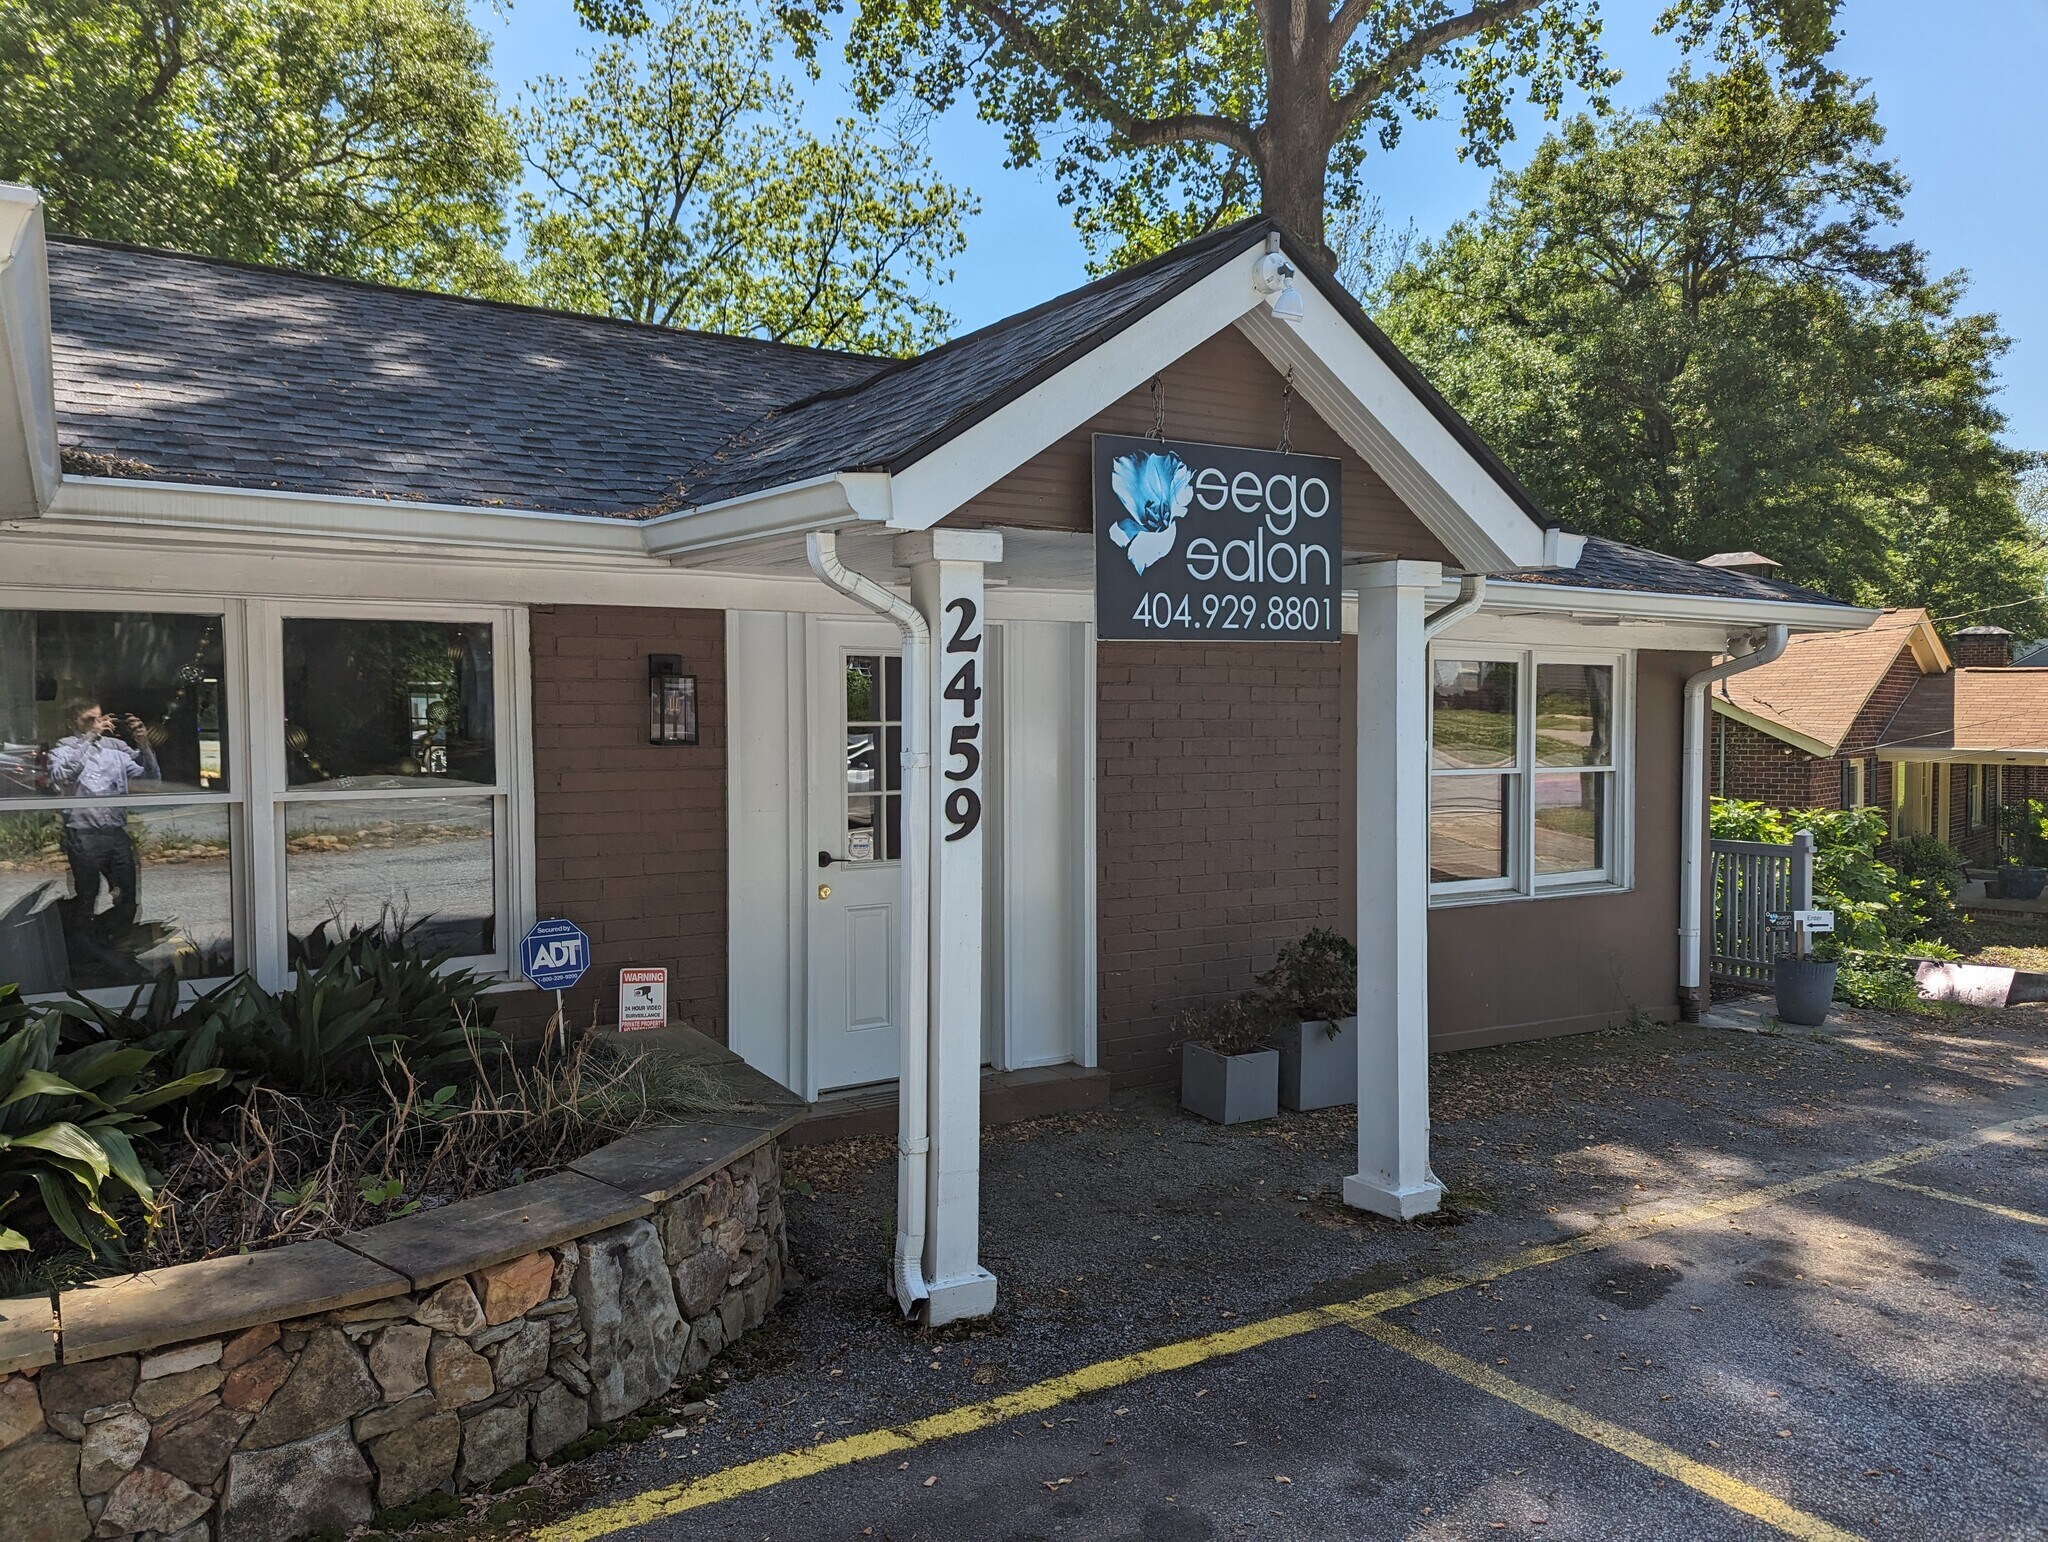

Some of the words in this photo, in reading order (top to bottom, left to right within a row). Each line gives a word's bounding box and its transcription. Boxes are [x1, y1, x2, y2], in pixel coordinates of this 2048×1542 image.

[1195, 467, 1330, 536] sego
[1186, 526, 1331, 585] salon
[1132, 592, 1331, 631] 404.929.8801
[943, 597, 982, 842] 2459
[537, 925, 563, 934] Secured
[532, 939, 581, 970] ADT
[623, 972, 664, 982] WARNING
